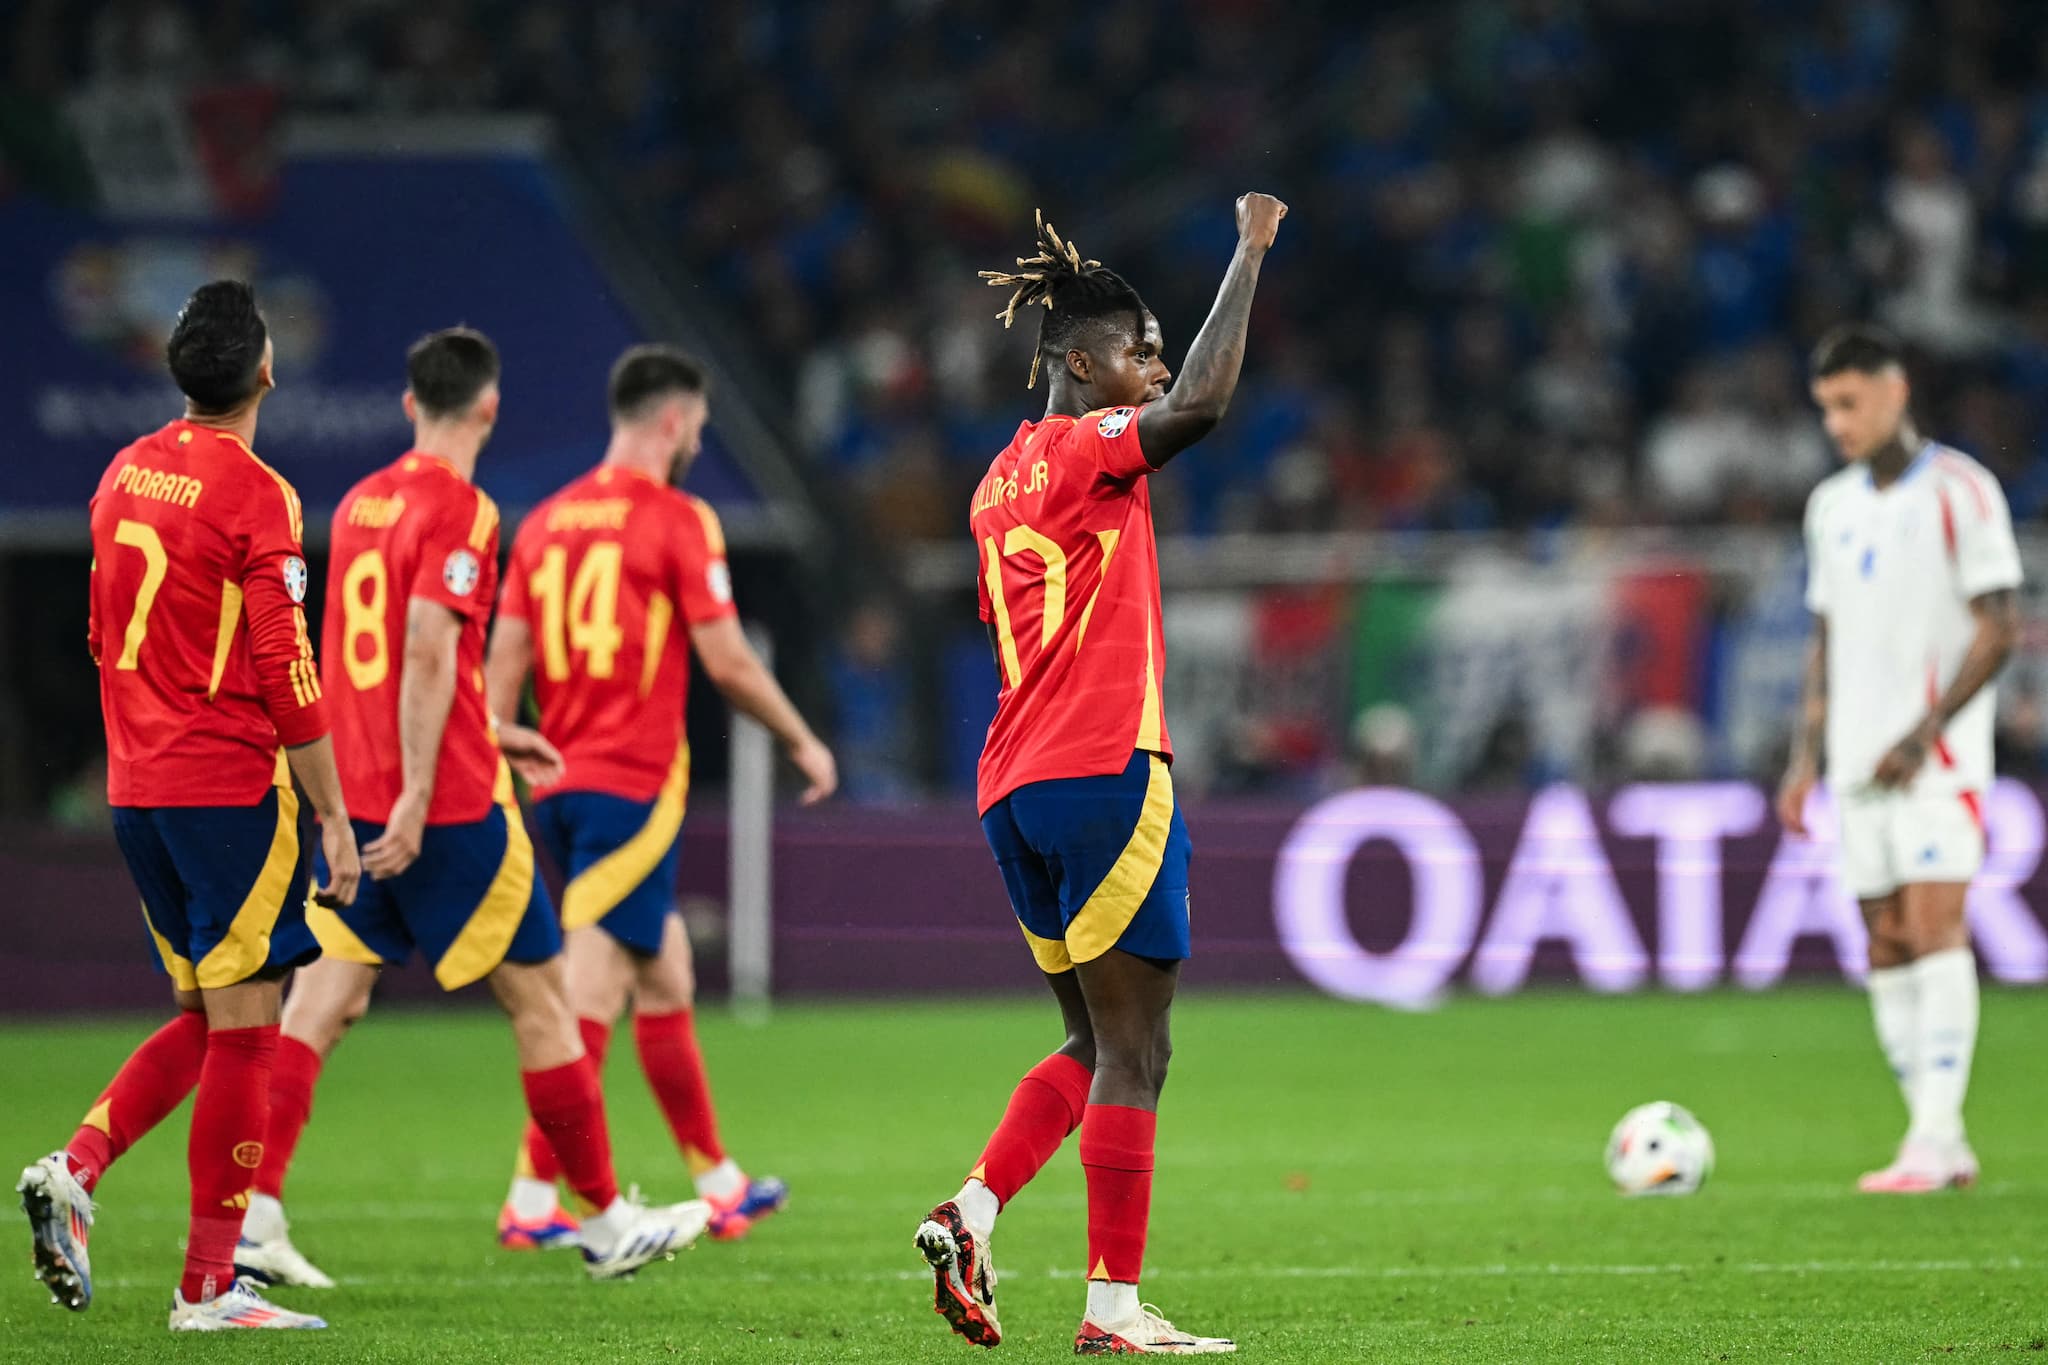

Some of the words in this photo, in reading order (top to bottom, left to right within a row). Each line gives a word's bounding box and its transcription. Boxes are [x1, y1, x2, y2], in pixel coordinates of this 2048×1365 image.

[113, 464, 203, 509] MORATA
[1023, 460, 1049, 495] JR
[114, 519, 168, 670] 7
[342, 549, 389, 691] 8
[529, 541, 623, 682] 14
[984, 524, 1067, 689] 17
